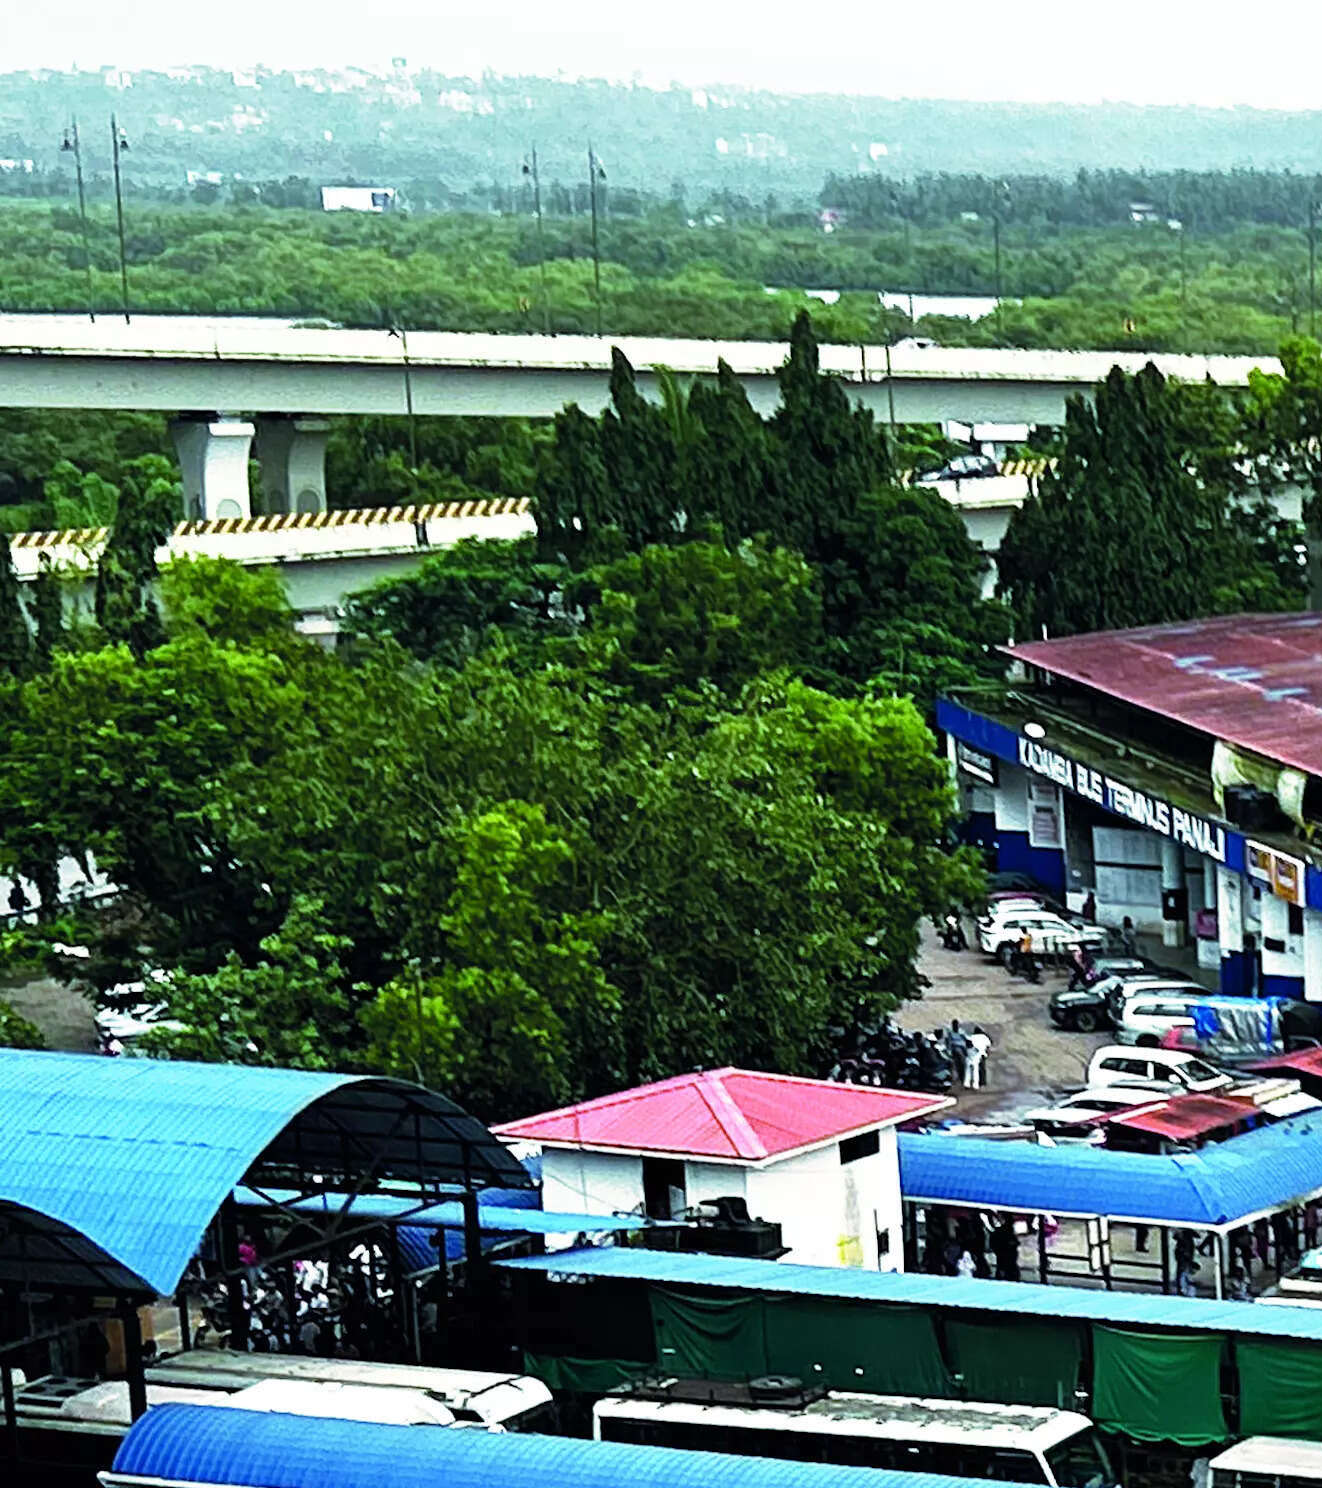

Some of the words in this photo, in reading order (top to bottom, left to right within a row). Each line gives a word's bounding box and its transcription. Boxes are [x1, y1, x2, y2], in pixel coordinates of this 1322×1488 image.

[1076, 762, 1103, 805] BUS
[1104, 776, 1170, 836] TERMINUS
[1172, 807, 1226, 863] PANAJI
